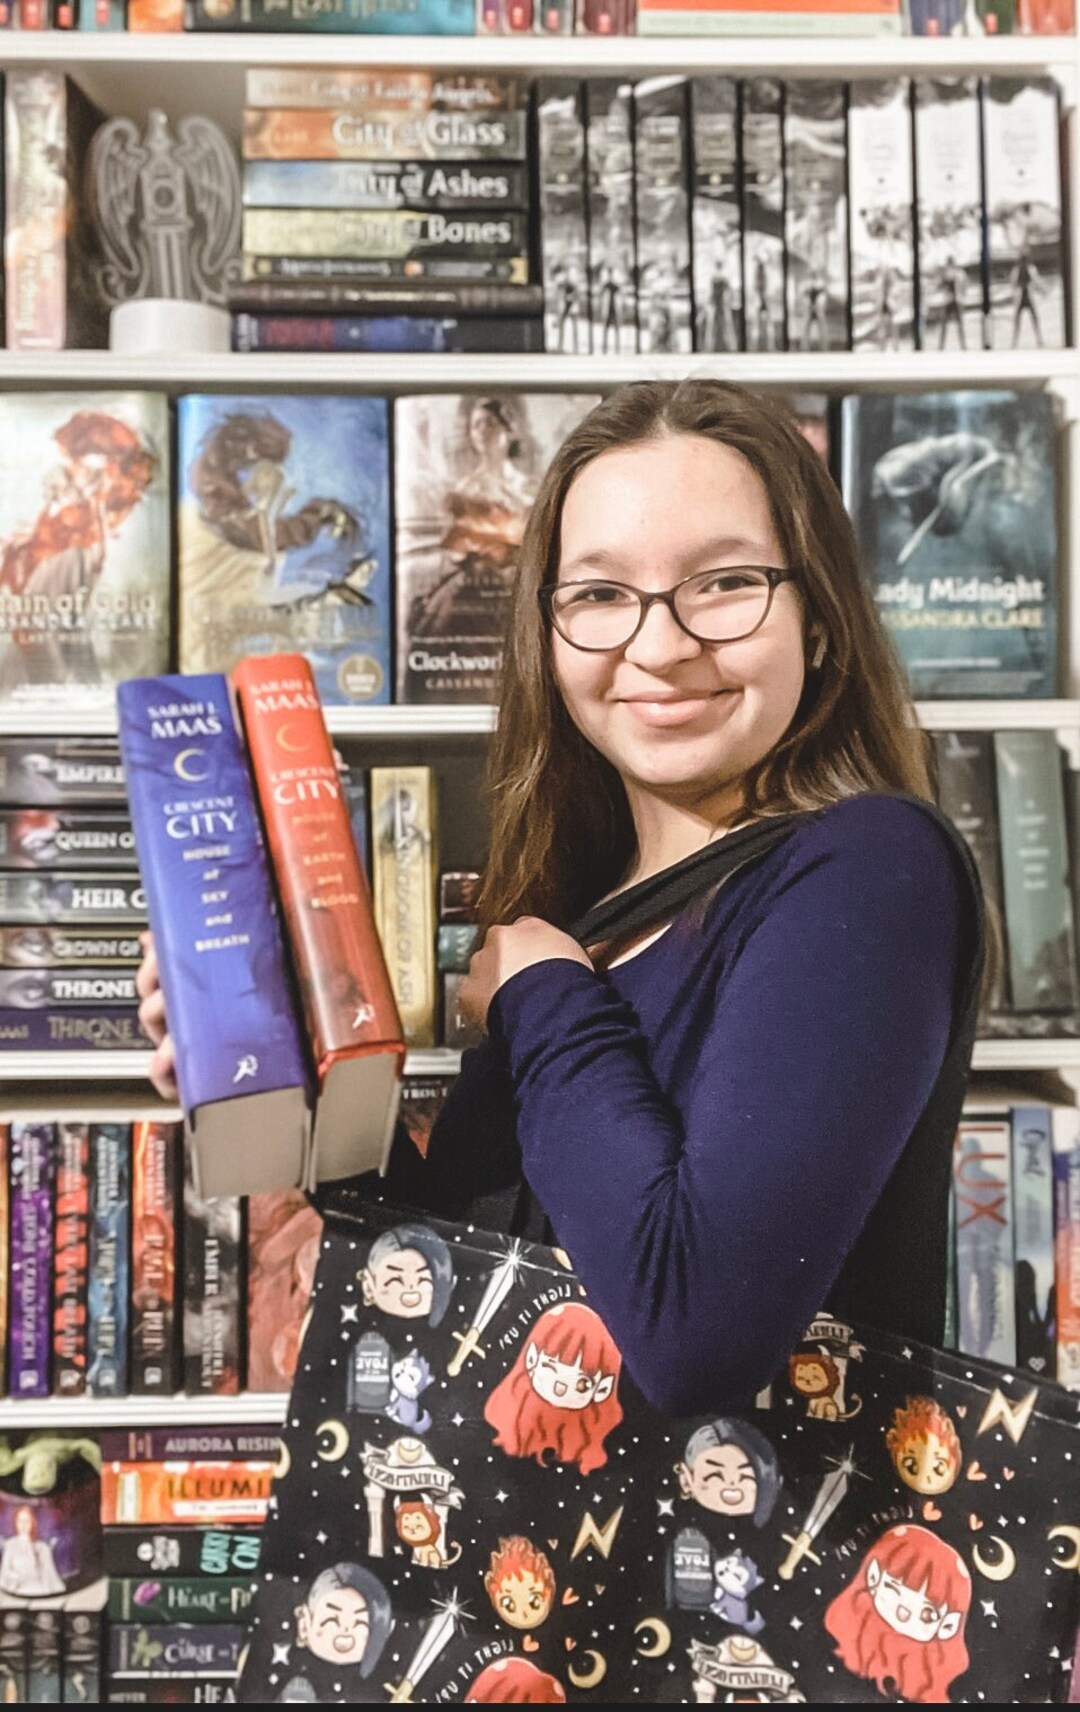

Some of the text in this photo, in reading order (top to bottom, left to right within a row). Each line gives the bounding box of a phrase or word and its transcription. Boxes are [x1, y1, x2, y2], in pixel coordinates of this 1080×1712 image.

[332, 116, 393, 150] City
[427, 115, 507, 147] Glass
[427, 168, 509, 198] Ashes
[428, 214, 513, 245] Bones
[56, 587, 88, 614] of
[874, 575, 1046, 609] ady Midnight
[147, 702, 204, 718] SARAH
[255, 695, 320, 714] MAAS
[151, 717, 223, 739] MAAS
[272, 779, 340, 806] CITY
[163, 796, 235, 815] CRESCENT
[166, 811, 238, 840] CITY
[55, 832, 135, 850] QUEEN O
[183, 845, 232, 861] HOUSE
[304, 852, 346, 866] EARTH
[202, 869, 220, 882] of
[72, 889, 127, 908] HEIR
[201, 890, 229, 905] SKY
[205, 913, 232, 927] and
[195, 935, 250, 953] BREATH
[52, 979, 136, 999] THRONE
[48, 1016, 133, 1042] THRONE
[954, 1126, 1008, 1230] LUX
[165, 1436, 281, 1453] AURORA RISIN
[167, 1478, 264, 1499] ILLUMI
[194, 1682, 237, 1704] HEA
